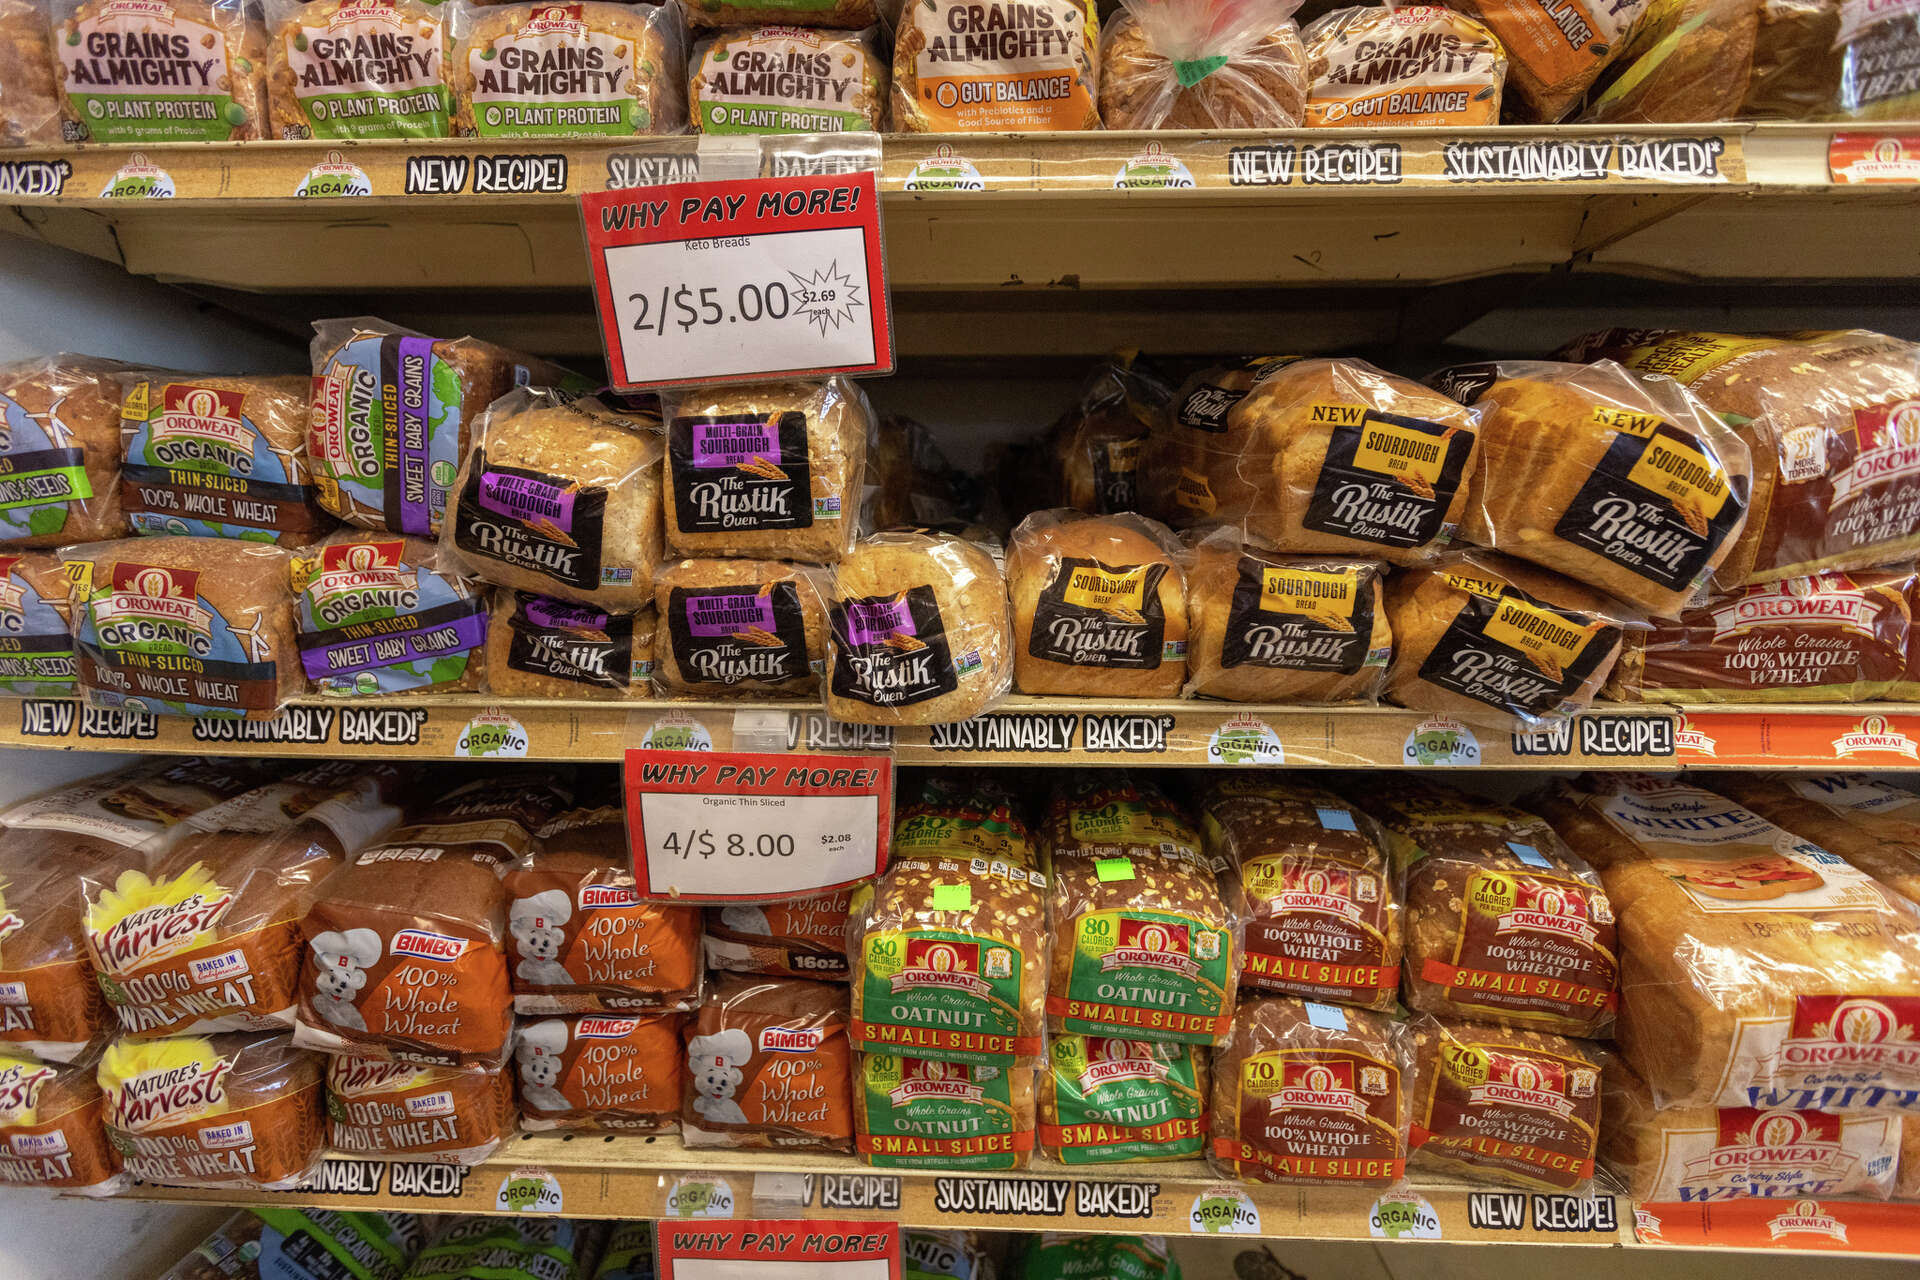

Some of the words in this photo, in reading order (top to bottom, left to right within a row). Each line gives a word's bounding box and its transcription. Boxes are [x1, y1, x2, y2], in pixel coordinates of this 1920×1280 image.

[527, 20, 579, 32] OROWEAT
[948, 4, 1054, 32] GRAINS
[88, 31, 189, 59] GRAINS
[929, 31, 1071, 62] ALMIGHTY
[500, 47, 603, 72] GRAINS
[73, 58, 212, 86] ALMIGHTY
[479, 67, 623, 94] ALMIGHTY
[961, 81, 993, 101] GUT
[996, 78, 1070, 100] BALANCE
[107, 100, 151, 121] PLANT
[156, 100, 217, 120] PROTEIN
[1027, 106, 1042, 114] and
[1351, 98, 1384, 116] GUT
[1388, 92, 1468, 114] BALANCE
[505, 109, 553, 125] PLANT
[558, 107, 620, 124] PROTEIN
[958, 118, 981, 126] Good
[985, 117, 1015, 126] Source
[1018, 117, 1027, 125] of
[1028, 116, 1051, 124] Fiber
[1233, 151, 1292, 184] NEW
[1305, 149, 1398, 182] RECIPE!
[1448, 144, 1610, 180] SUSTAINABLY
[407, 160, 468, 194] NEW
[477, 156, 565, 191] RECIPE!
[602, 201, 668, 231] WHY
[680, 194, 746, 224] PAY
[756, 187, 861, 217] MORE!
[685, 238, 709, 251] Keto
[712, 236, 750, 248] Breads
[803, 290, 835, 303] $2.69
[629, 282, 789, 335] 2/$5.00
[813, 308, 830, 316] each
[406, 356, 423, 408] GRAINS
[329, 379, 342, 459] OROWEAT
[349, 370, 380, 476] ORGANIC
[1312, 406, 1361, 423] NEW
[1594, 408, 1655, 433] NEW
[167, 418, 238, 437] OROWEAT
[384, 384, 398, 470] THIN-SLICED
[406, 415, 424, 450] BABY
[706, 426, 763, 437] MULTI-GRAIN
[155, 441, 252, 474] ORGANIC
[700, 438, 770, 454] SOURDOUGH
[1366, 431, 1440, 464] SOURDOUGH
[726, 456, 744, 464] BREAD
[1388, 458, 1408, 471] BREAD
[1647, 446, 1724, 497] SOURDOUGH
[1794, 457, 1816, 468] MORE
[170, 470, 248, 493] THIN-SLICED
[405, 453, 424, 503] SWEET
[720, 476, 744, 491] The
[1788, 466, 1822, 480] TOPPING
[690, 483, 794, 518] Rustik
[1370, 483, 1393, 500] The
[140, 488, 178, 509] 100%
[184, 493, 226, 517] WHOLE
[233, 504, 278, 524] WHEAT
[1331, 484, 1435, 535] Rustik
[1637, 502, 1664, 525] The
[722, 514, 758, 527] Oven
[1351, 521, 1386, 539] Oven
[1592, 497, 1702, 571] Rustik
[1604, 540, 1643, 565] Oven
[1073, 574, 1138, 594] SOURDOUGH
[1449, 576, 1500, 596] NEW
[116, 598, 194, 619] OROWEAT
[1739, 600, 1854, 618] OROWEAT
[341, 615, 418, 640] THIN-SLICED
[1082, 616, 1102, 630] The
[1501, 606, 1582, 651] SOURDOUGH
[101, 622, 210, 655] ORGANIC
[1050, 617, 1148, 656] Rustik
[1738, 636, 1786, 653] Whole
[1794, 634, 1852, 650] Grains
[328, 646, 370, 670] SWEET
[374, 639, 406, 660] BABY
[413, 629, 459, 652] GRAINS
[1723, 652, 1775, 669] 100%
[1778, 651, 1859, 666] WHOLE
[118, 651, 204, 674] THIN-SLICED
[1750, 668, 1827, 684] WHEAT
[137, 673, 190, 697] WHOLE
[194, 679, 240, 703] WHEAT
[24, 703, 72, 734] NEW
[82, 705, 156, 736] RECIPE!
[934, 718, 1077, 748] SUSTAINABLY
[1583, 720, 1671, 752] RECIPE!
[1846, 735, 1902, 747] OROWEAT
[1210, 740, 1280, 757] ORGANIC
[1406, 740, 1477, 758] ORGANIC
[642, 764, 707, 784] WHY
[715, 766, 776, 786] PAY
[784, 768, 880, 788] MORE!
[703, 797, 736, 807] Organic
[738, 798, 758, 806] Thin
[760, 798, 785, 807] Sliced
[663, 829, 716, 859] 4/$
[727, 833, 795, 857] 8.00
[821, 834, 851, 844] $2.08
[114, 895, 202, 939] NATURE'S
[90, 896, 230, 970] Harvest
[396, 934, 462, 957] BIMBO
[872, 938, 897, 957] 80
[197, 957, 224, 972] BAKED
[227, 954, 236, 964] IN
[869, 953, 901, 967] CALORIES
[1118, 951, 1184, 967] OROWEAT
[1487, 945, 1526, 960] 100%
[1530, 952, 1593, 971] WHOLE
[1506, 960, 1566, 978] WHEAT
[121, 971, 191, 1004] 100%
[396, 964, 458, 988] 100%
[905, 972, 974, 988] OROWEAT
[385, 986, 458, 1014] Whole
[906, 993, 937, 1004] Whole
[941, 994, 976, 1008] Grains
[1097, 984, 1191, 1007] OATNUT
[1454, 970, 1528, 993] SMALL
[1536, 980, 1608, 1008] SLICE
[384, 1012, 460, 1036] Wheat
[891, 1006, 986, 1027] OATNUT
[1068, 1002, 1143, 1025] SMALL
[1151, 1013, 1216, 1032] SLICE
[762, 1031, 818, 1048] BIMBO
[865, 1025, 942, 1046] SMALL
[950, 1033, 1016, 1052] SLICE
[124, 1061, 201, 1099] NATURE'S
[1250, 1062, 1275, 1079] 70
[108, 1063, 230, 1128] Harvest
[760, 1079, 825, 1102] Whole
[1247, 1079, 1279, 1089] CALORIES
[1283, 1091, 1350, 1105] OROWEAT
[761, 1102, 829, 1123] Wheat
[1284, 1115, 1315, 1126] Whole
[1319, 1117, 1356, 1131] Grains
[334, 1123, 383, 1150] WHOLE
[390, 1116, 458, 1148] WHEAT
[1264, 1126, 1306, 1141] 100%
[1309, 1130, 1371, 1145] WHOLE
[190, 1146, 257, 1174] WHEAT
[1287, 1142, 1349, 1156] WHEAT
[1714, 1148, 1828, 1167] OROWEAT
[1328, 1161, 1393, 1177] SLICE
[937, 1178, 1069, 1213] SUSTAINABLY
[1372, 1210, 1437, 1231] ORGANIC
[1472, 1194, 1523, 1226] NEW
[1535, 1195, 1615, 1229] RECIPE!
[1779, 1218, 1833, 1228] OROWEAT
[674, 1233, 732, 1250] WHY
[740, 1233, 795, 1251] PAY
[802, 1234, 888, 1252] MORE!
